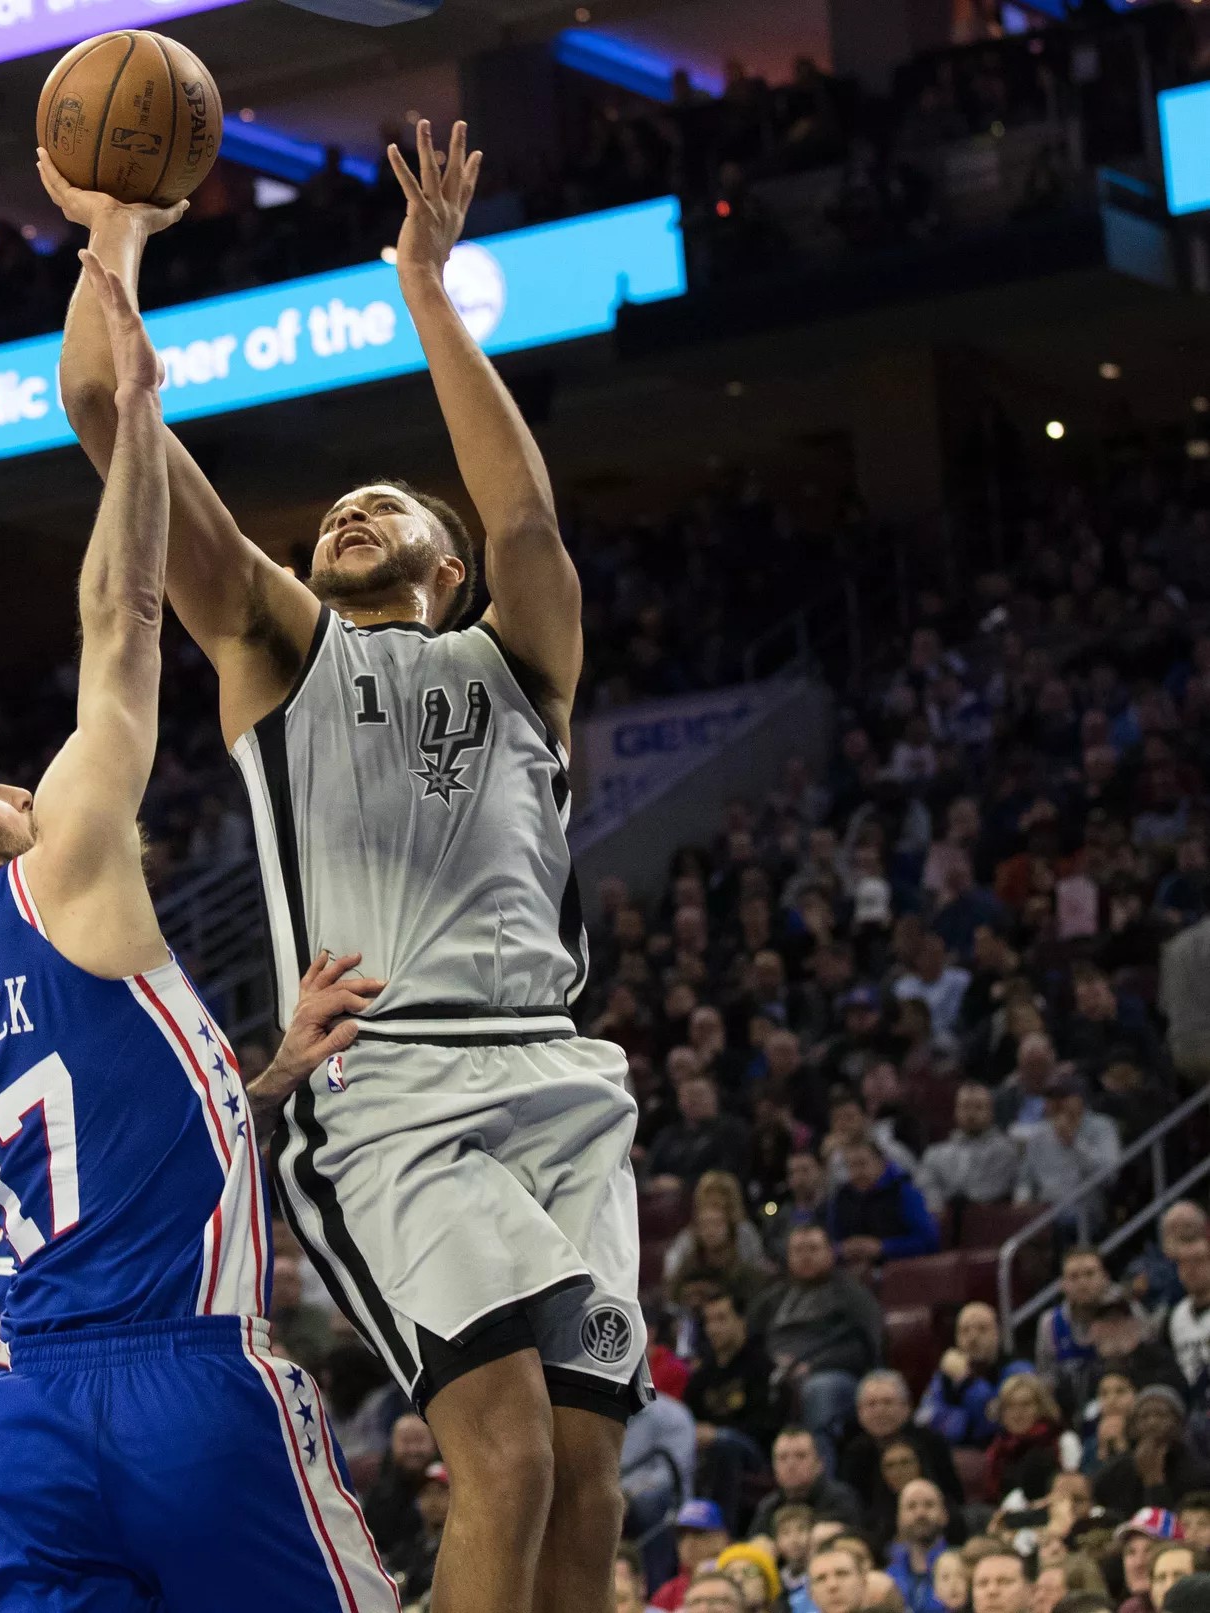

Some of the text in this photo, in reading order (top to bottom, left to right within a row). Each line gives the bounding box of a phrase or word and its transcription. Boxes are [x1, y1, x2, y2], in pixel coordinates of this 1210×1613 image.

[243, 307, 302, 371] of
[307, 298, 396, 357] the
[353, 673, 390, 727] 1
